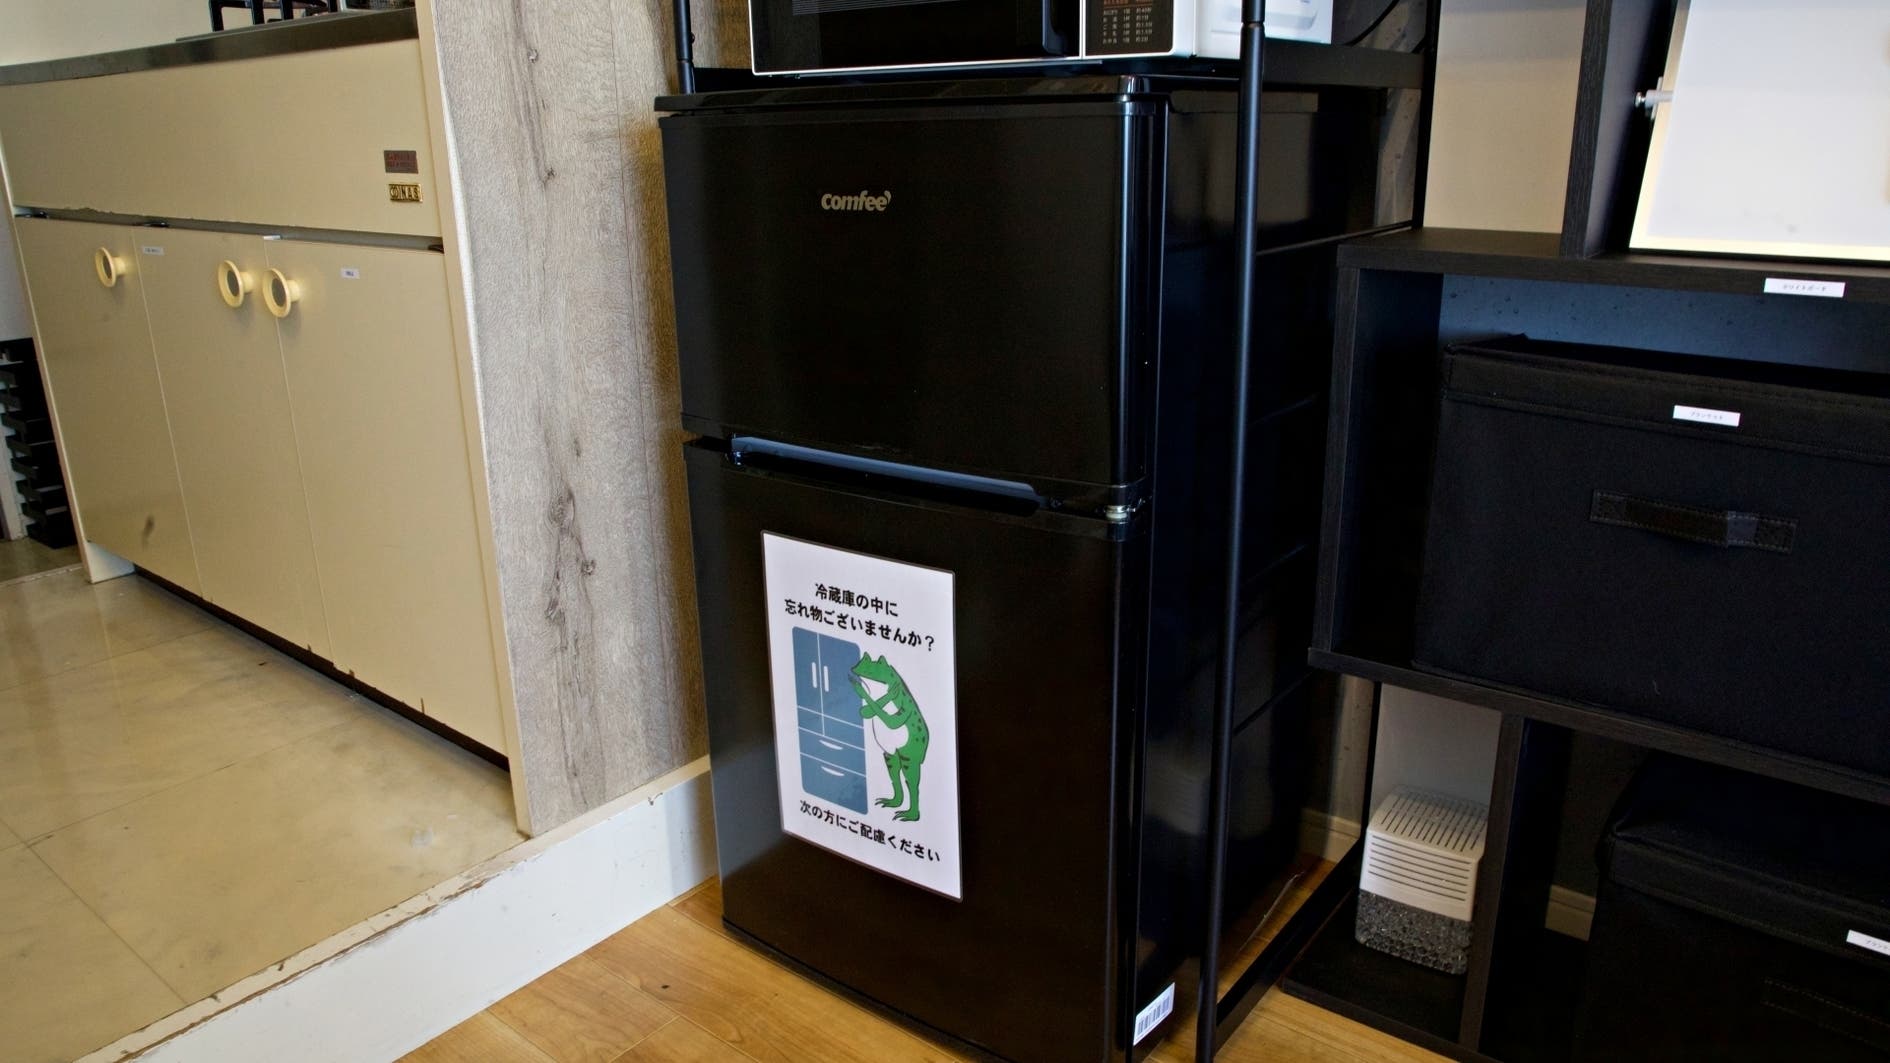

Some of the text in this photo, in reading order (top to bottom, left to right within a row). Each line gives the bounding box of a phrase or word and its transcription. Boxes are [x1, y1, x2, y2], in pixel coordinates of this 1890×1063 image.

[814, 583, 899, 617] 冷蔵庫の中に
[799, 800, 942, 862] 次の方にご配慮ください
